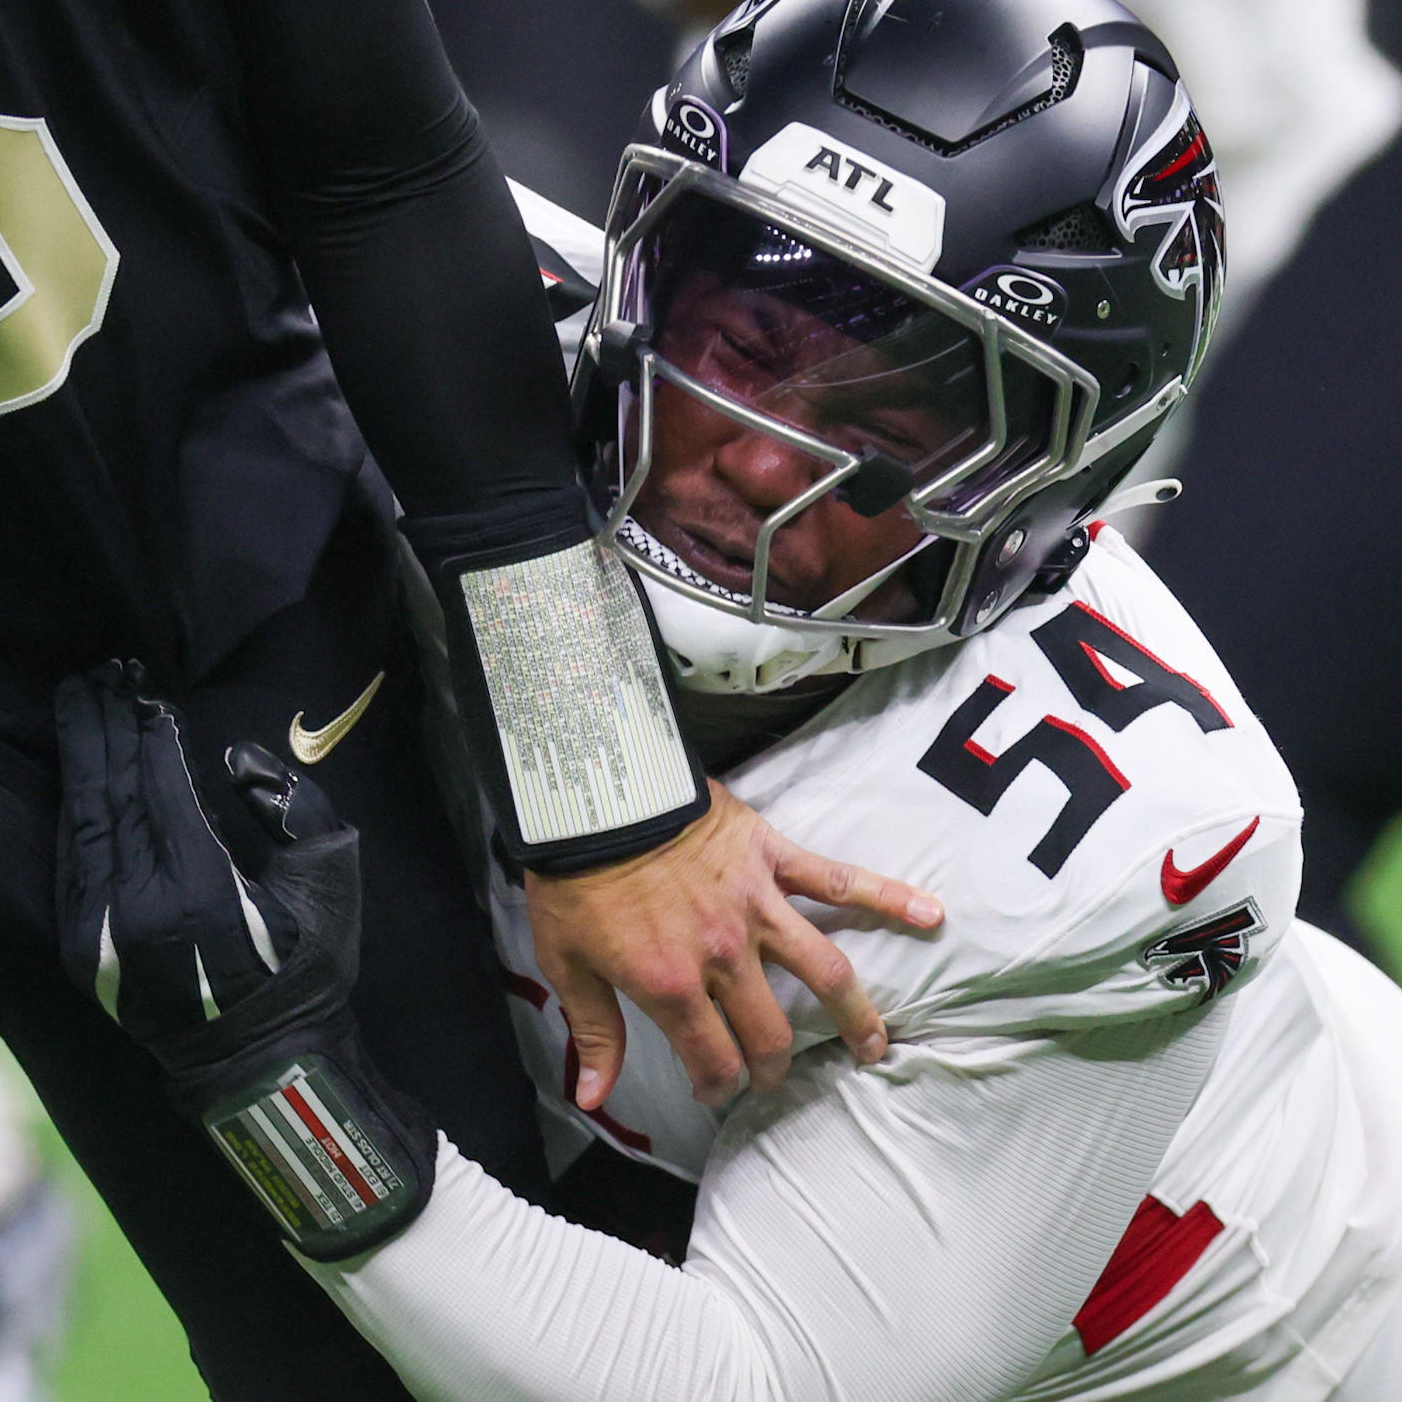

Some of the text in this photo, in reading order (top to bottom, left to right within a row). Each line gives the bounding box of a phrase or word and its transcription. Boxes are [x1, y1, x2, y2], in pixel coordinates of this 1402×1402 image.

[666, 118, 718, 161] OAKLEY
[805, 145, 895, 214] ATL
[974, 287, 1058, 325] OAKLEY
[916, 599, 1236, 880] 54
